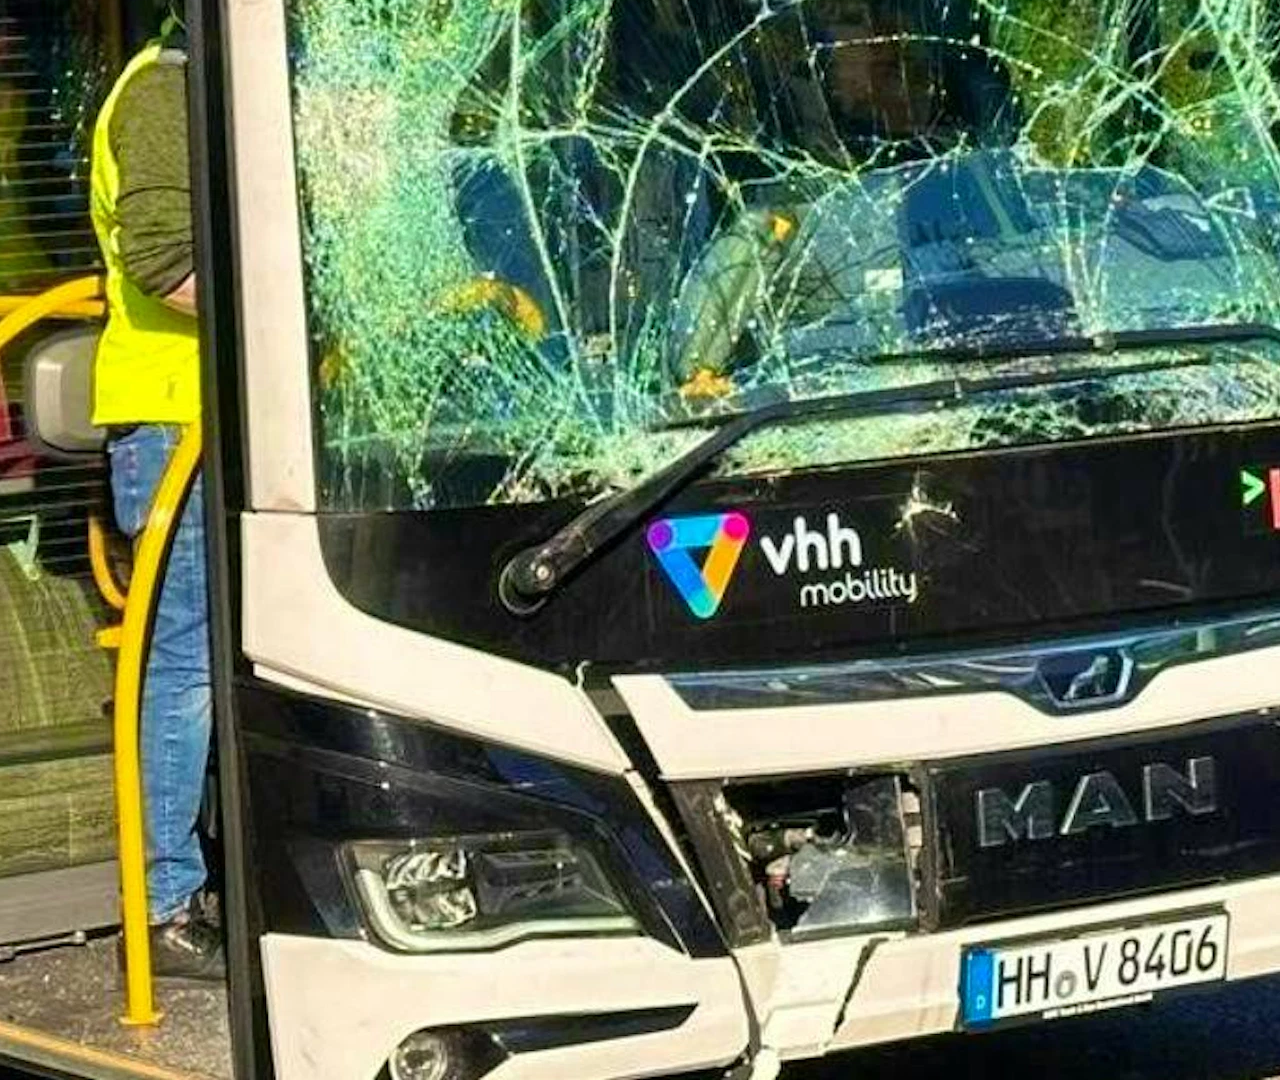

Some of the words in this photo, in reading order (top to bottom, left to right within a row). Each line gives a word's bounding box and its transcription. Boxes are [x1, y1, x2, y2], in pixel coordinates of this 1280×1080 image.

[759, 513, 863, 576] vhh
[799, 567, 919, 608] mobility
[977, 757, 1217, 848] MAN
[997, 951, 1052, 1009] HH
[1084, 942, 1108, 991] V
[1117, 924, 1219, 986] 8406
